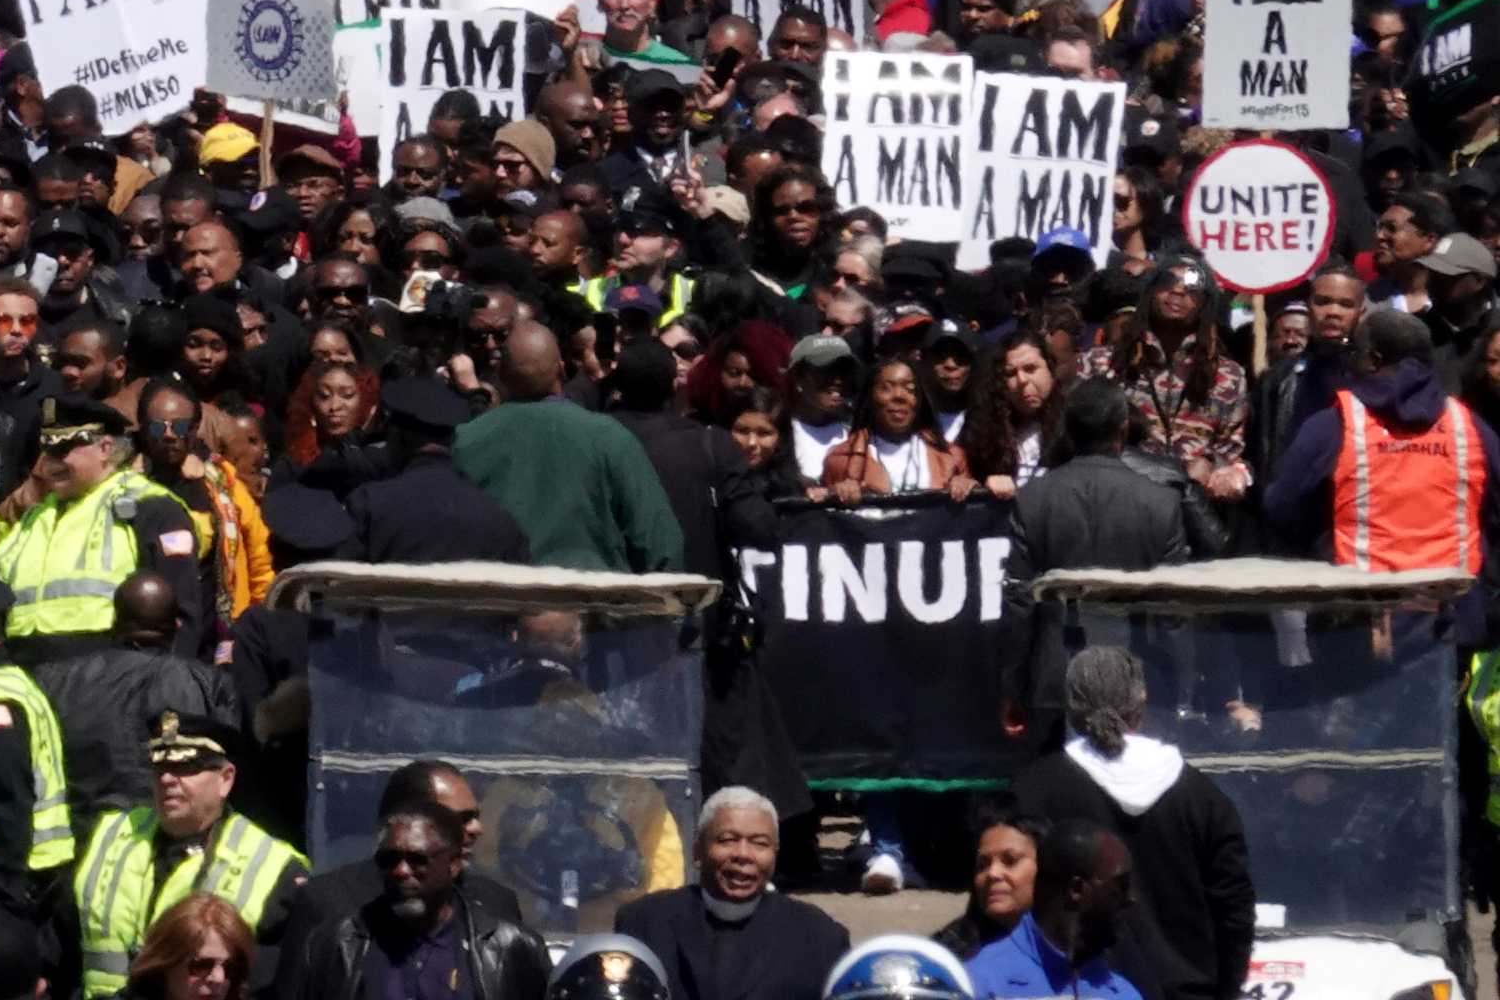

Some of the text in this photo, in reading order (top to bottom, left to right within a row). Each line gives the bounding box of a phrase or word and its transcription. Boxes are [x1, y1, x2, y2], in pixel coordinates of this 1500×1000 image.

[389, 19, 515, 89] I AM
[1262, 10, 1288, 55] A
[1435, 23, 1472, 70] AM
[74, 38, 188, 85] #IDefineMe
[1240, 60, 1308, 97] MAN
[100, 74, 180, 119] #MLK50
[979, 85, 1113, 159] I AM
[834, 135, 961, 208] A MAN
[972, 165, 996, 240] A
[1199, 182, 1320, 214] UNITE
[1201, 218, 1317, 254] HERE!
